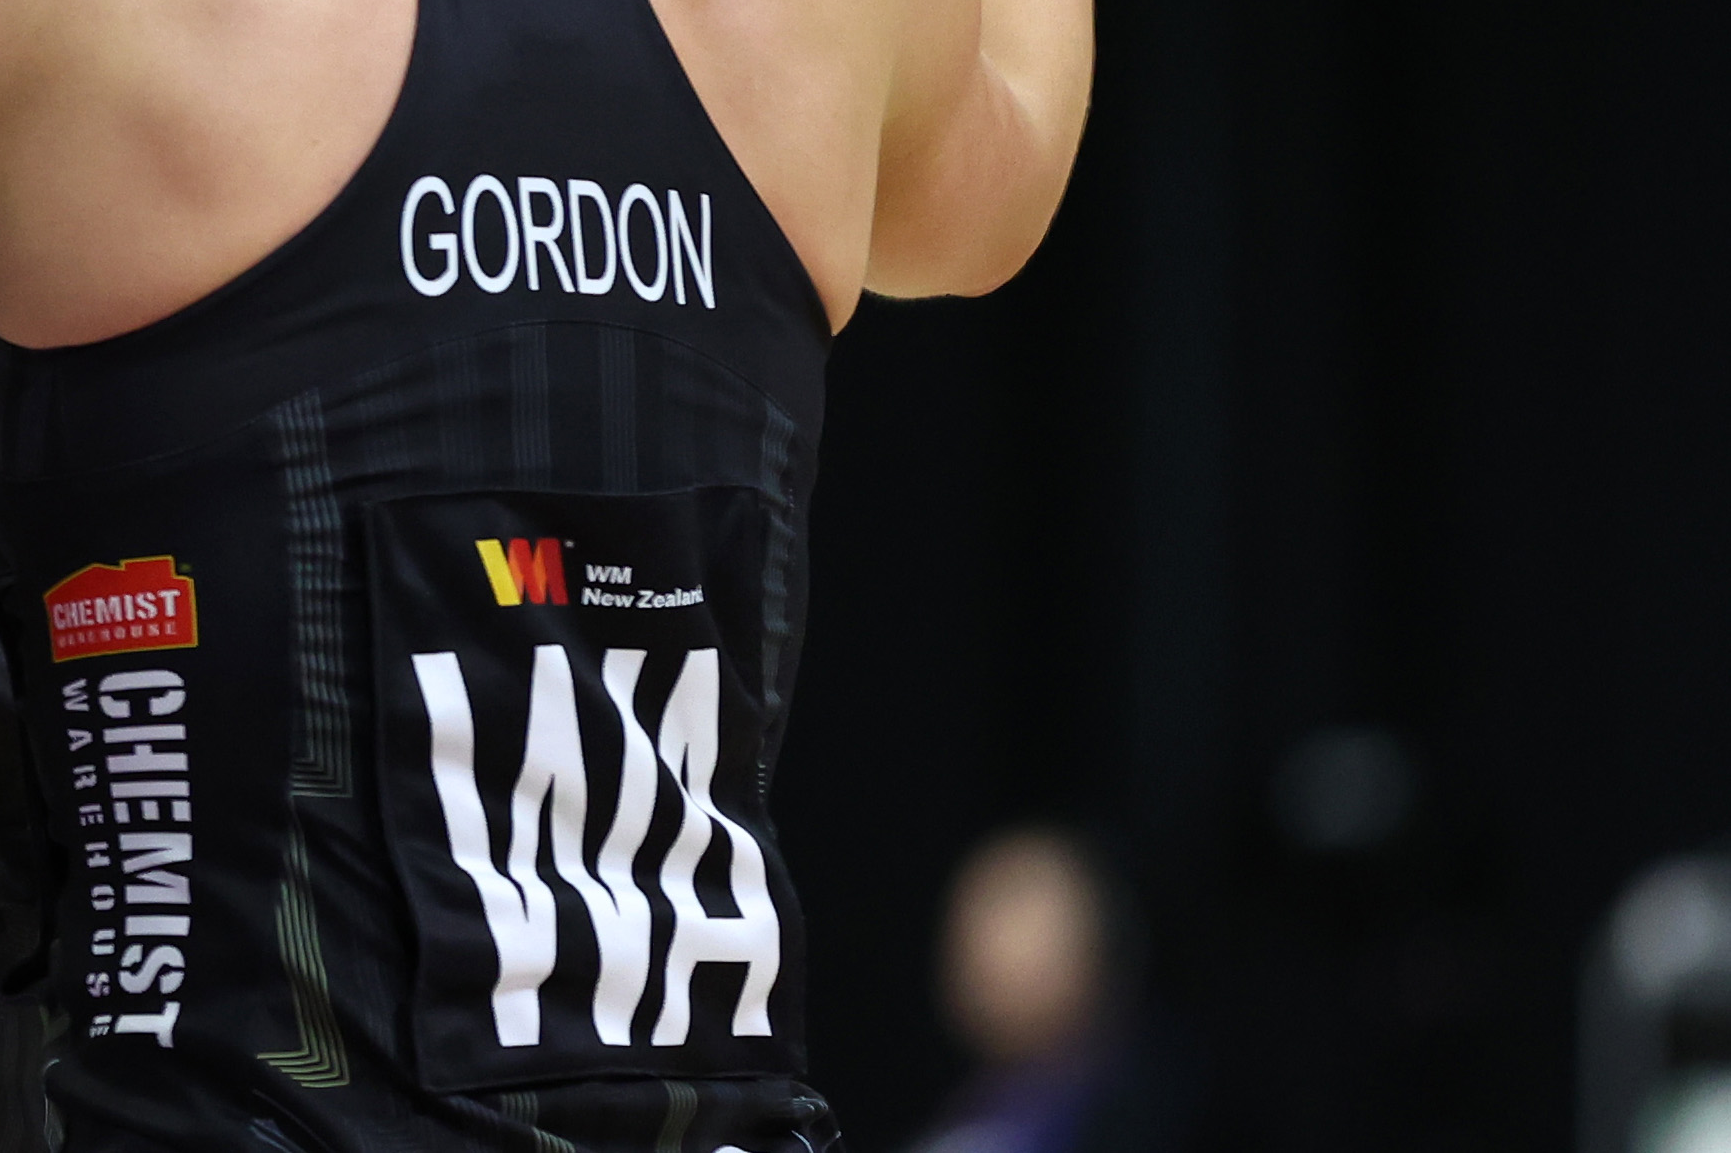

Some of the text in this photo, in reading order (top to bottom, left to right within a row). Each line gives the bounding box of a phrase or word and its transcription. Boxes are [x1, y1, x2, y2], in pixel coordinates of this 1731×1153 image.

[400, 174, 716, 309] GORDON
[53, 589, 181, 630] CHEMIST
[581, 588, 635, 608] New
[585, 564, 633, 585] WM
[62, 678, 116, 1039] WAREHOUSE
[98, 669, 193, 1048] CHEMIST
[411, 644, 781, 1047] WA
